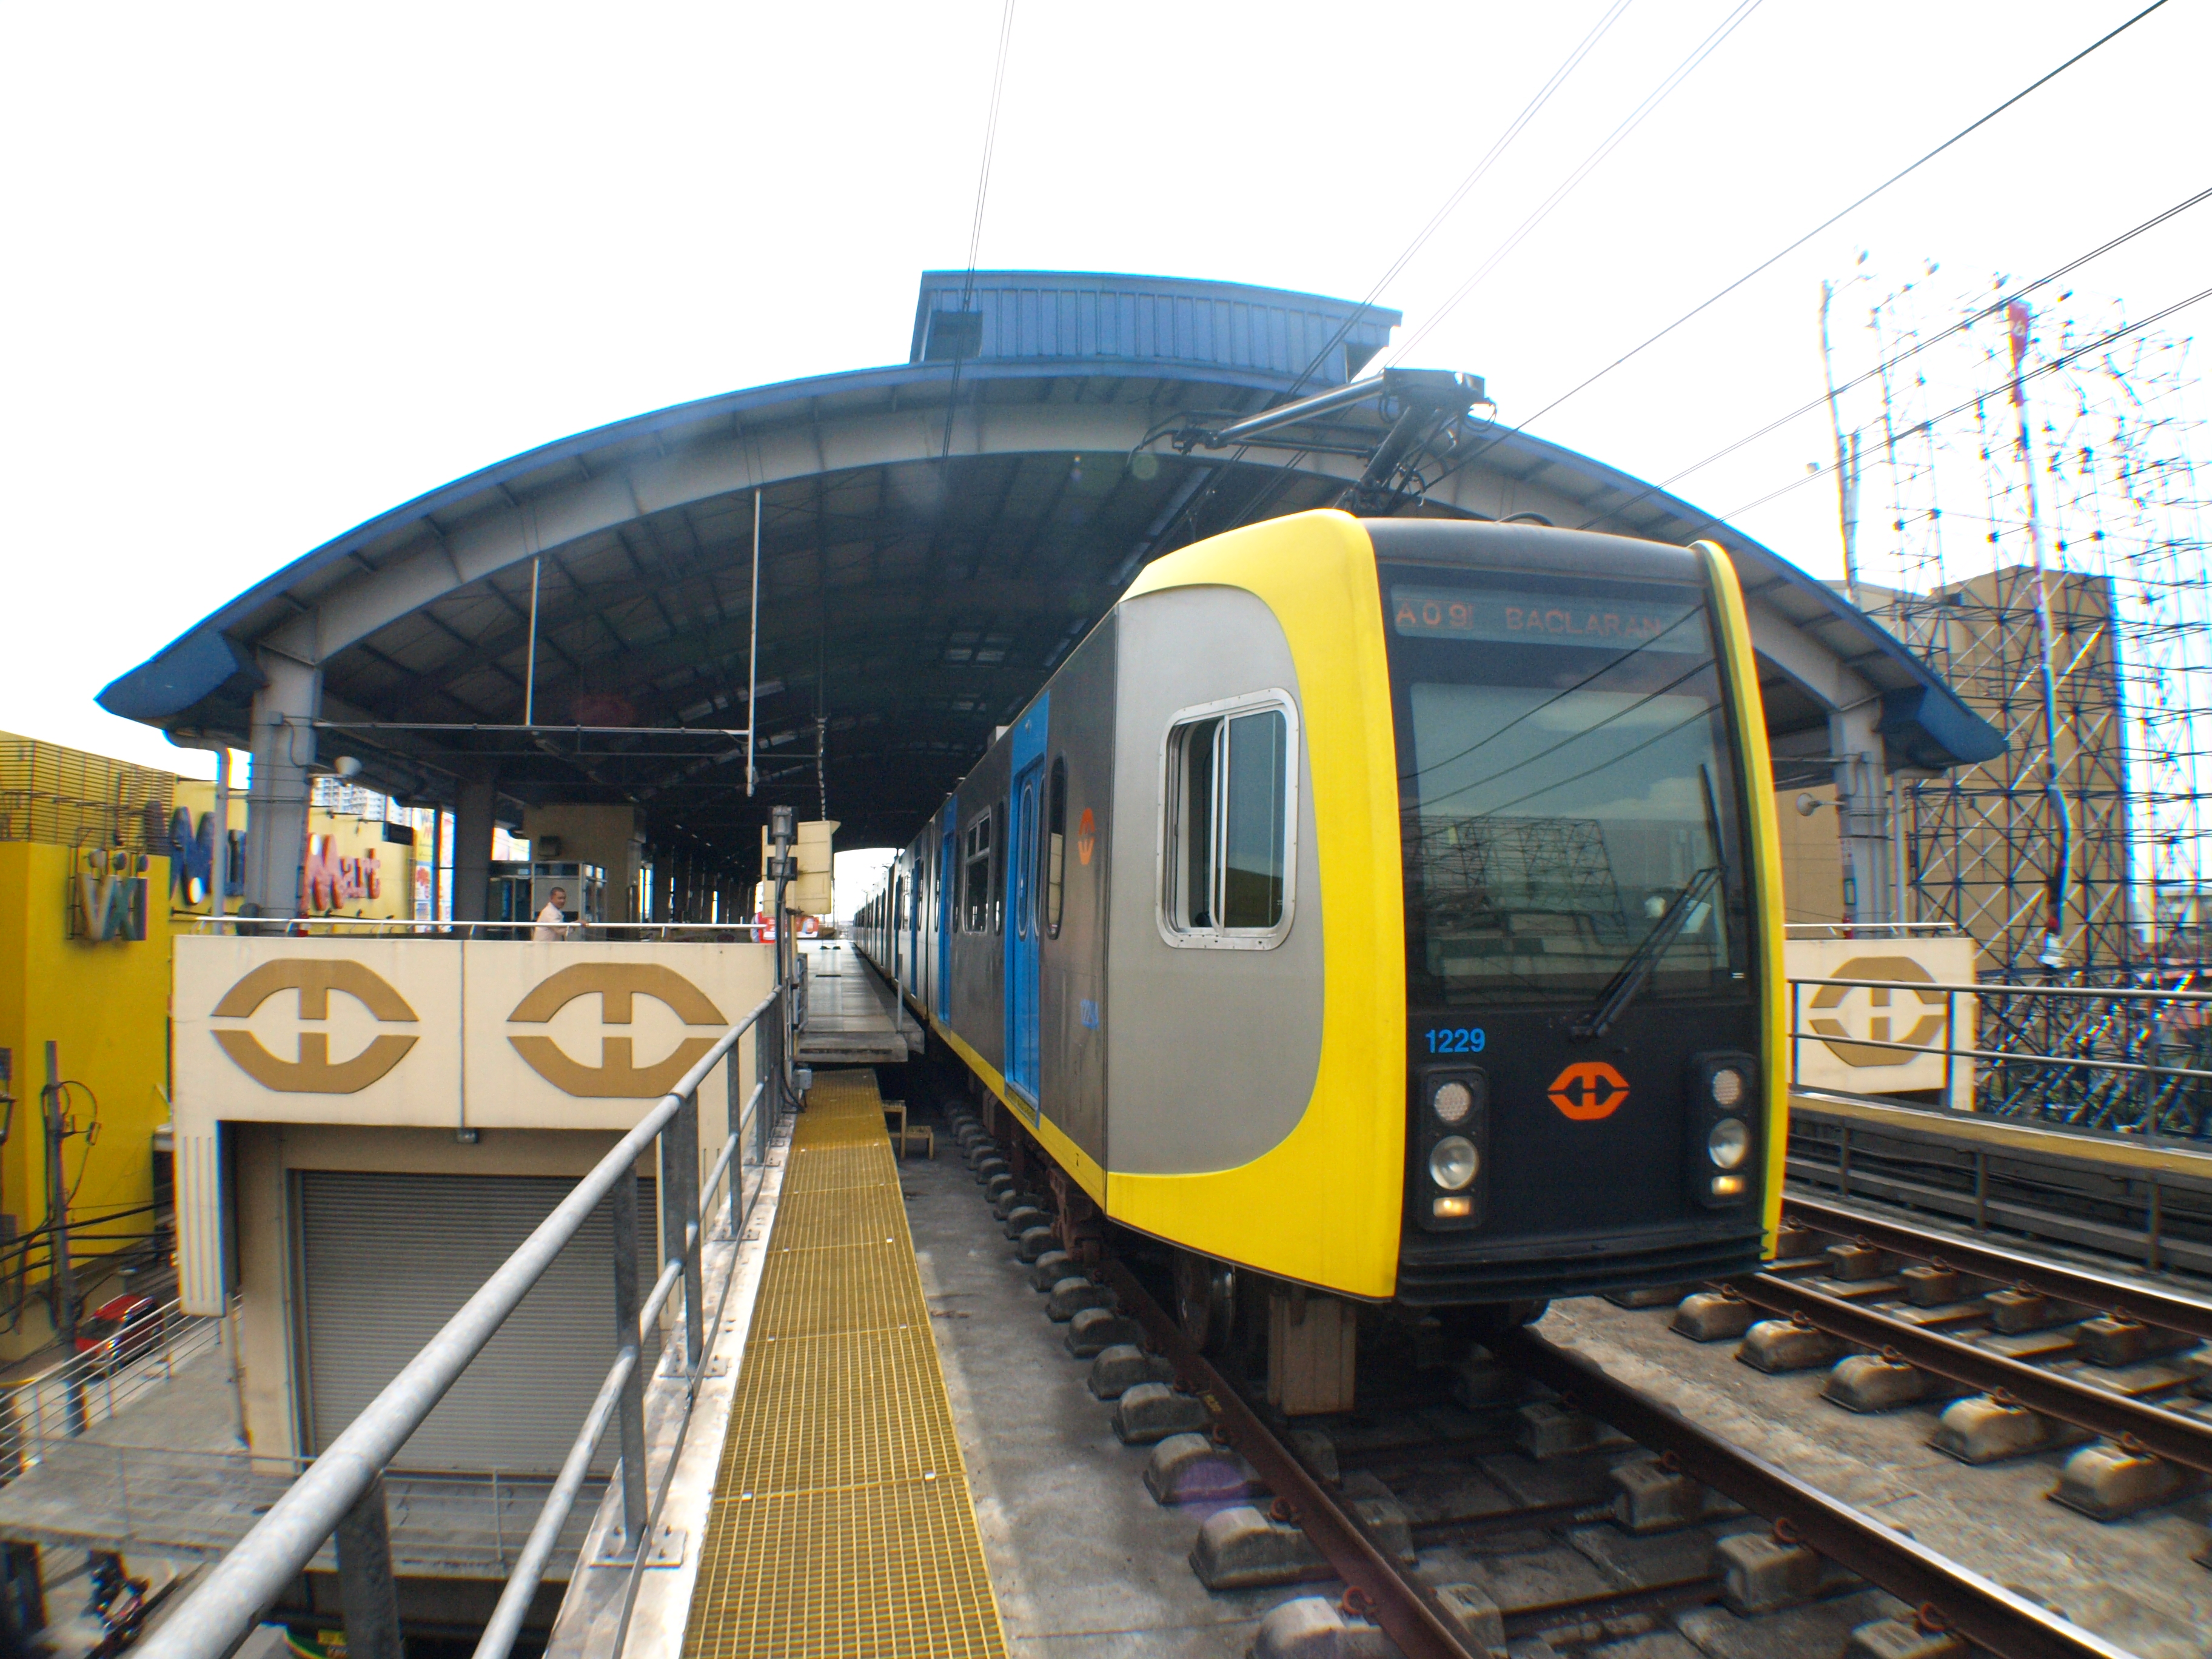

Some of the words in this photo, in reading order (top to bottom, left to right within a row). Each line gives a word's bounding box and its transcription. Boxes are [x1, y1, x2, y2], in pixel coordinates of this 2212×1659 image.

[1506, 608, 1661, 638] BACLARAN
[300, 833, 381, 911] Mart
[1424, 1027, 1486, 1053] 1229
